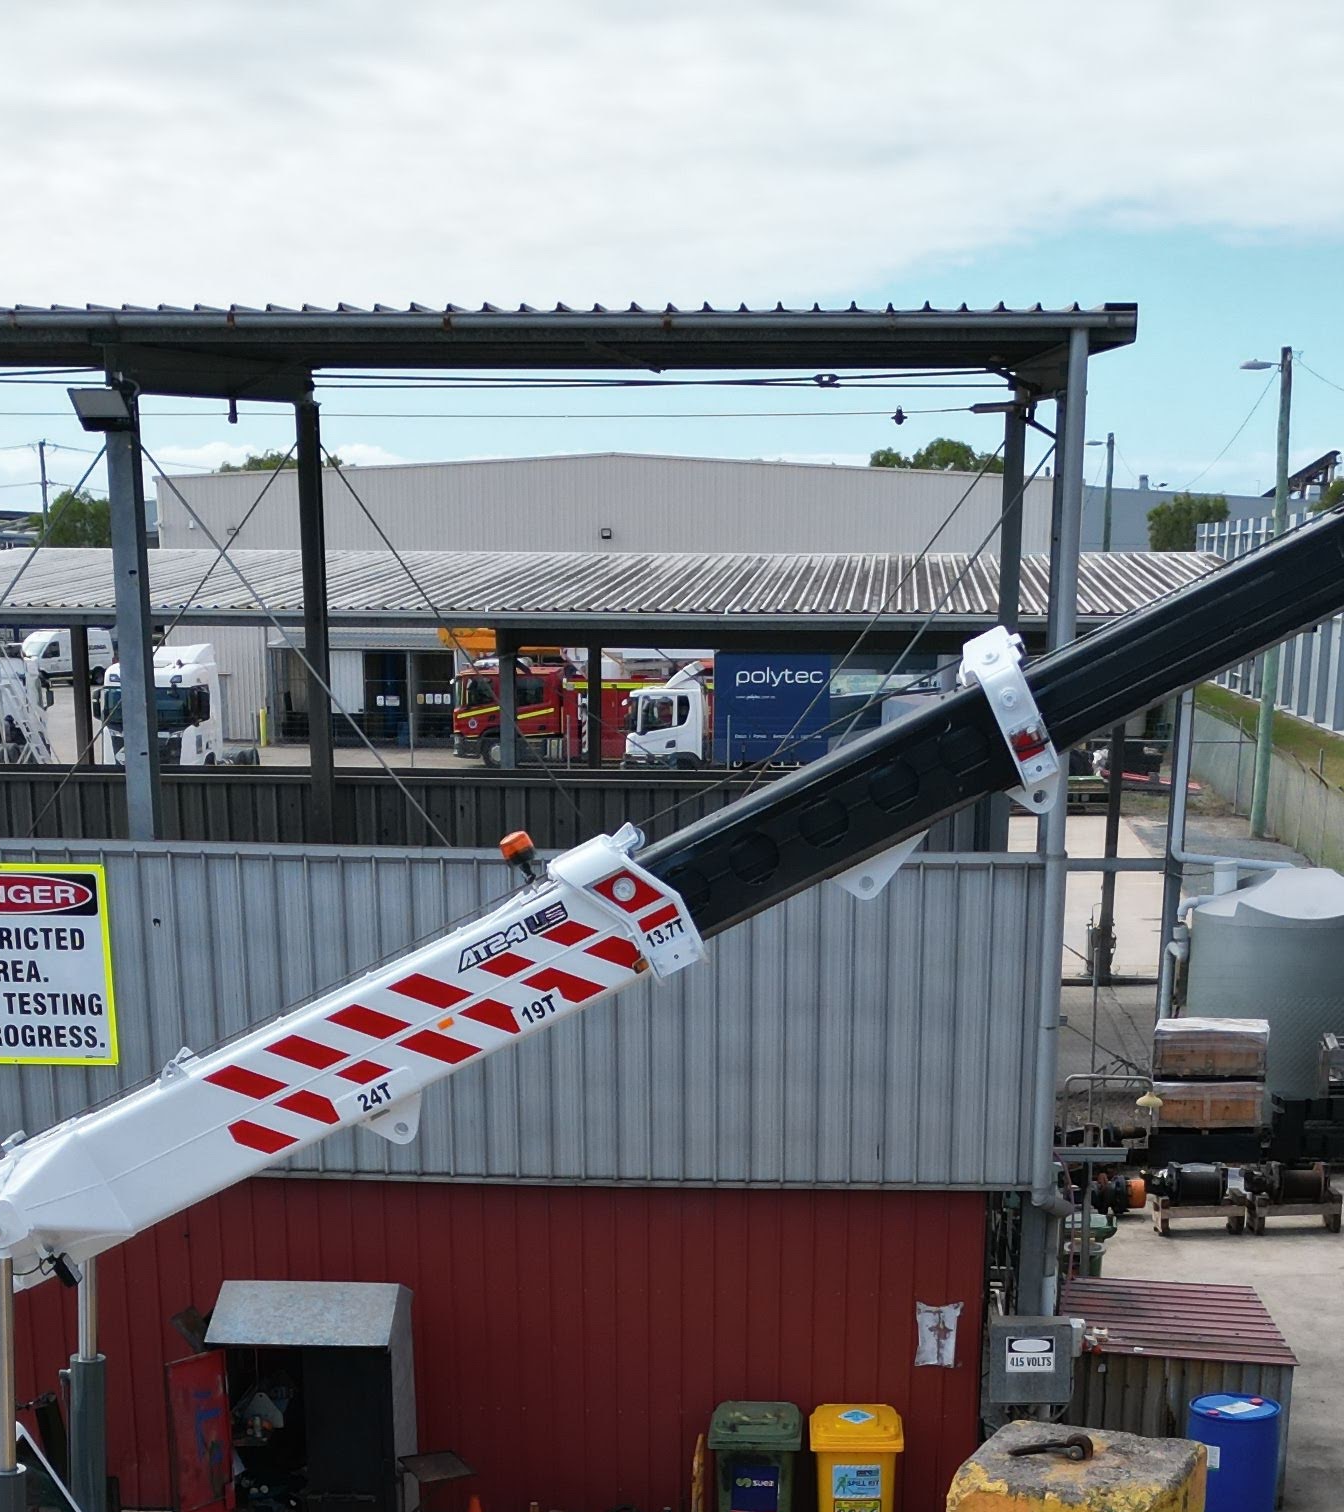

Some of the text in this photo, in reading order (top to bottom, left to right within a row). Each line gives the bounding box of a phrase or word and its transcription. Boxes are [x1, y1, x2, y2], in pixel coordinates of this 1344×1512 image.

[735, 666, 824, 687] polytec
[458, 921, 529, 974] AT24
[645, 918, 686, 949] 13.7T
[2, 992, 103, 1016] TESTING
[521, 994, 557, 1025] 19T
[357, 1081, 393, 1113] 24T
[1009, 1356, 1052, 1367] 415 VOLTS
